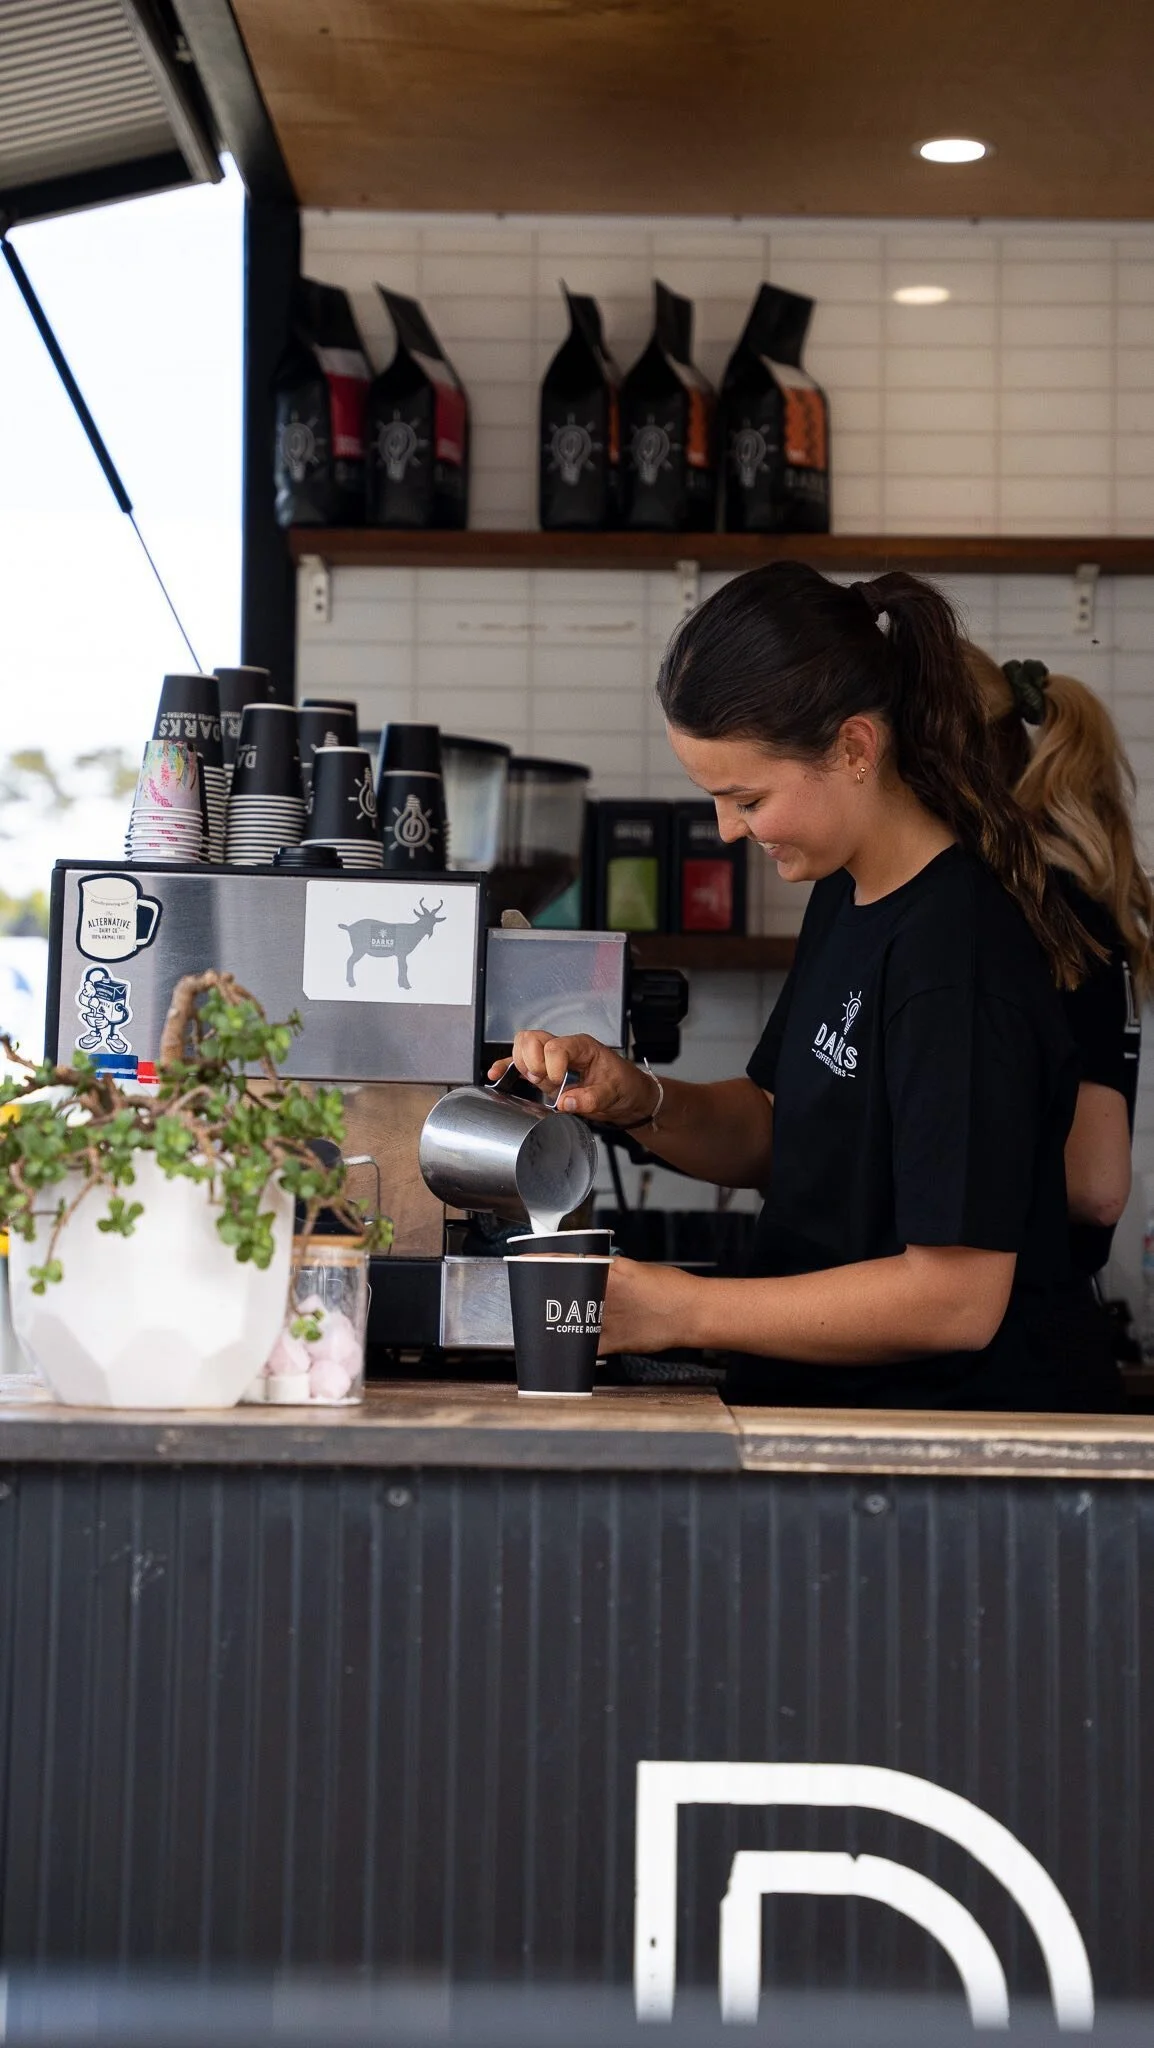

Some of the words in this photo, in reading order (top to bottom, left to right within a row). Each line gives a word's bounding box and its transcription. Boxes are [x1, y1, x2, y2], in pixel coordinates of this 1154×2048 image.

[158, 719, 220, 741] DARKS
[88, 917, 131, 929] ALTERNATIVE
[556, 1325, 584, 1334] COFFEE
